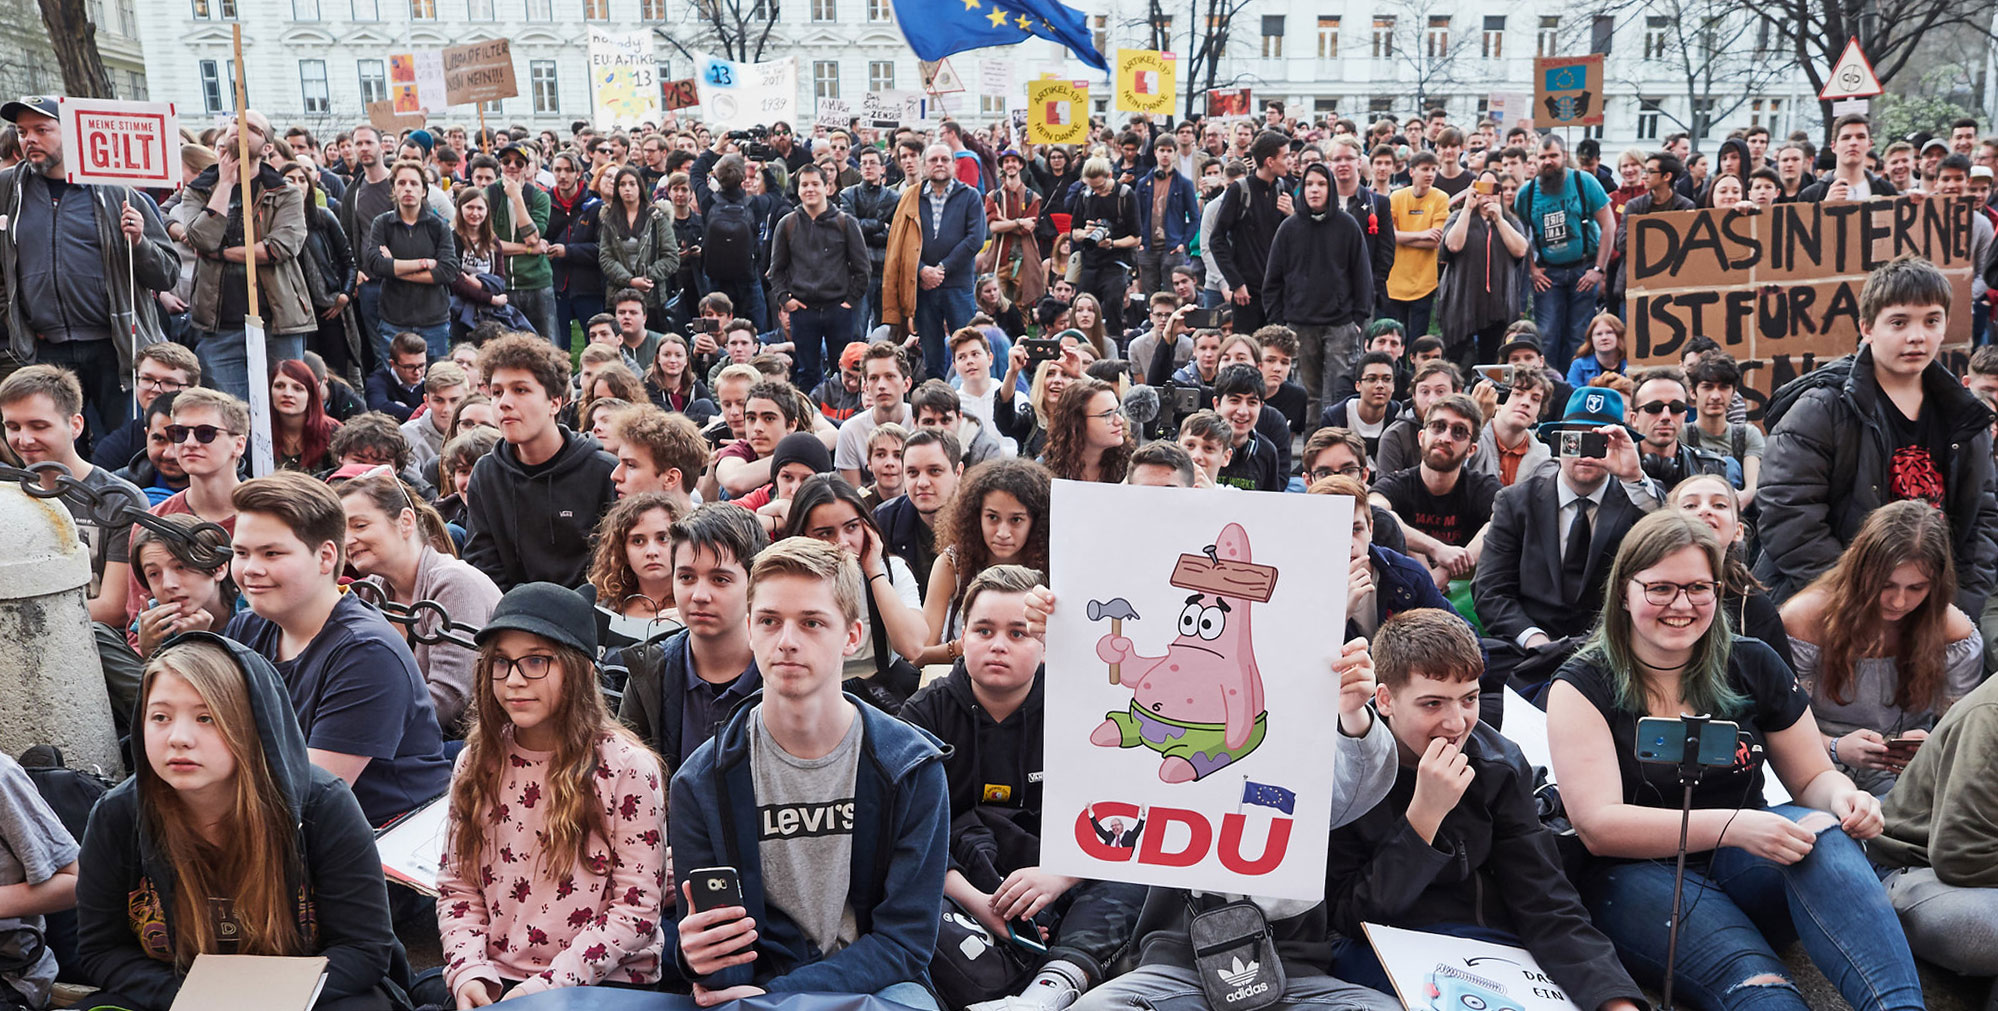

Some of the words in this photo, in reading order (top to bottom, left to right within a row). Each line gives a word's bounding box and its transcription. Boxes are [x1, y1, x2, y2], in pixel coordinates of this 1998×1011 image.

[1123, 55, 1156, 73] ARTIKEL
[632, 70, 652, 87] 13
[711, 64, 732, 85] 13
[669, 81, 694, 107] 13
[761, 97, 787, 111] 1939
[1034, 85, 1068, 105] ARTIKEL
[1122, 90, 1141, 109] NEIN
[1142, 92, 1169, 110] DANKE
[88, 119, 116, 131] MEINE
[119, 121, 154, 133] STIMME
[1034, 122, 1054, 140] NEIN
[1055, 121, 1082, 142] DANKE
[90, 131, 154, 170] G!LT
[1634, 206, 1763, 281] DAS
[1771, 193, 1976, 273] INTERNET
[1634, 291, 1720, 359] IST
[1725, 284, 1817, 346] FÜR
[1075, 801, 1294, 876] CDU
[1522, 970, 1557, 985] DAS
[1226, 982, 1269, 1003] adidas
[1533, 987, 1564, 1002] EIN
